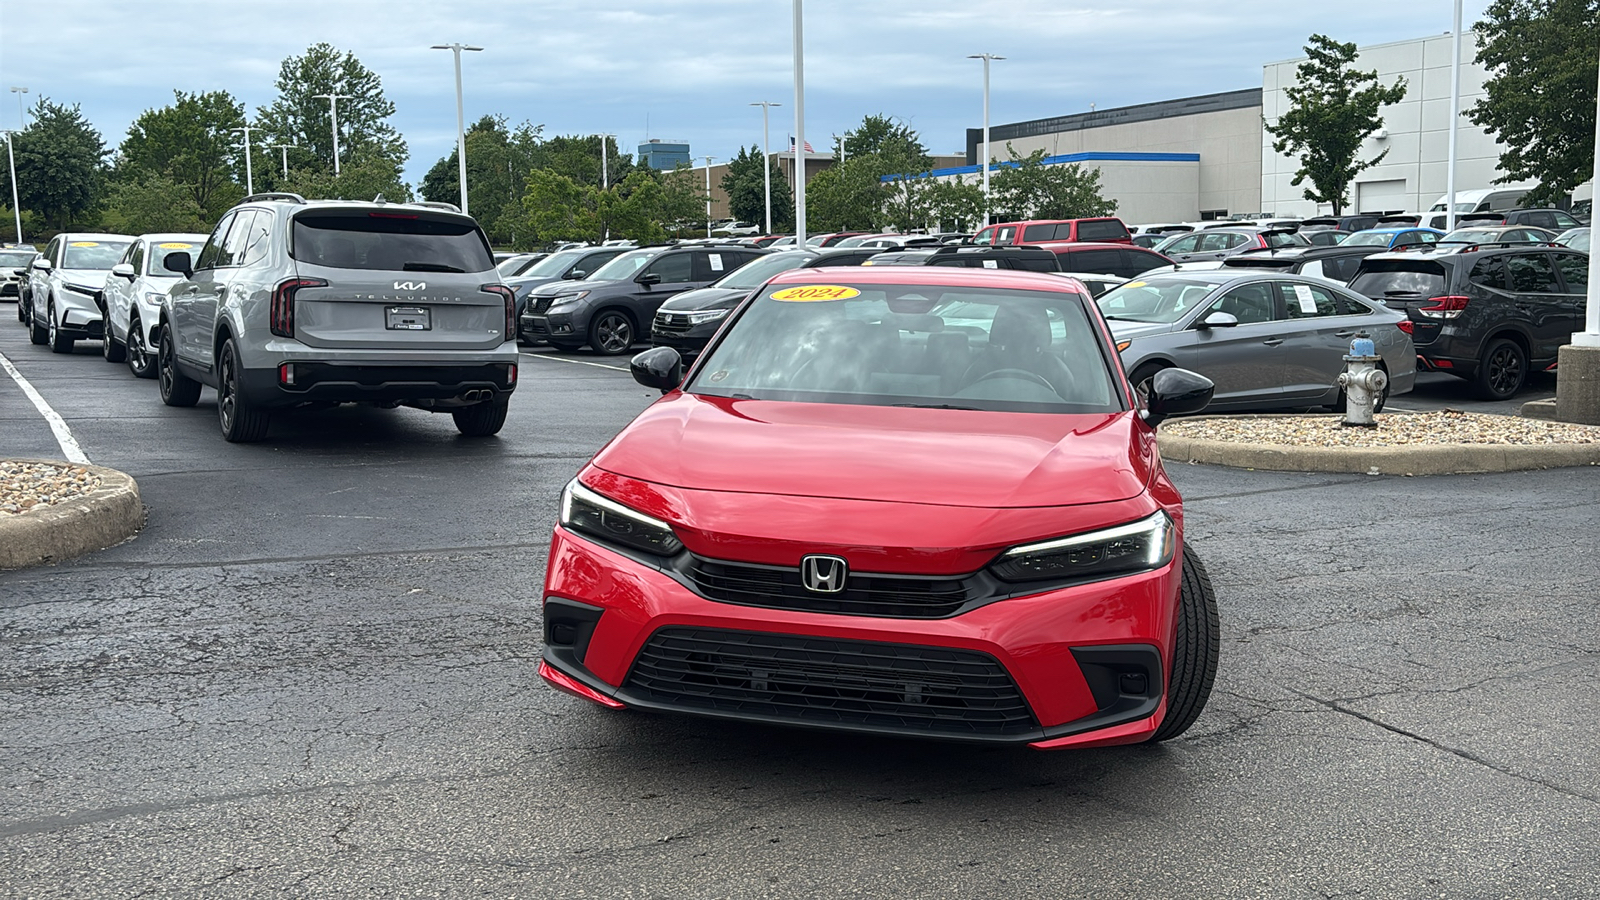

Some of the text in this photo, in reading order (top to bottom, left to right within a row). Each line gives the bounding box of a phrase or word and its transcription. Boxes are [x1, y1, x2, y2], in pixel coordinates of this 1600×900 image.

[393, 281, 426, 291] KIA
[355, 294, 461, 302] TELLURIDE
[783, 288, 848, 299] 2024
